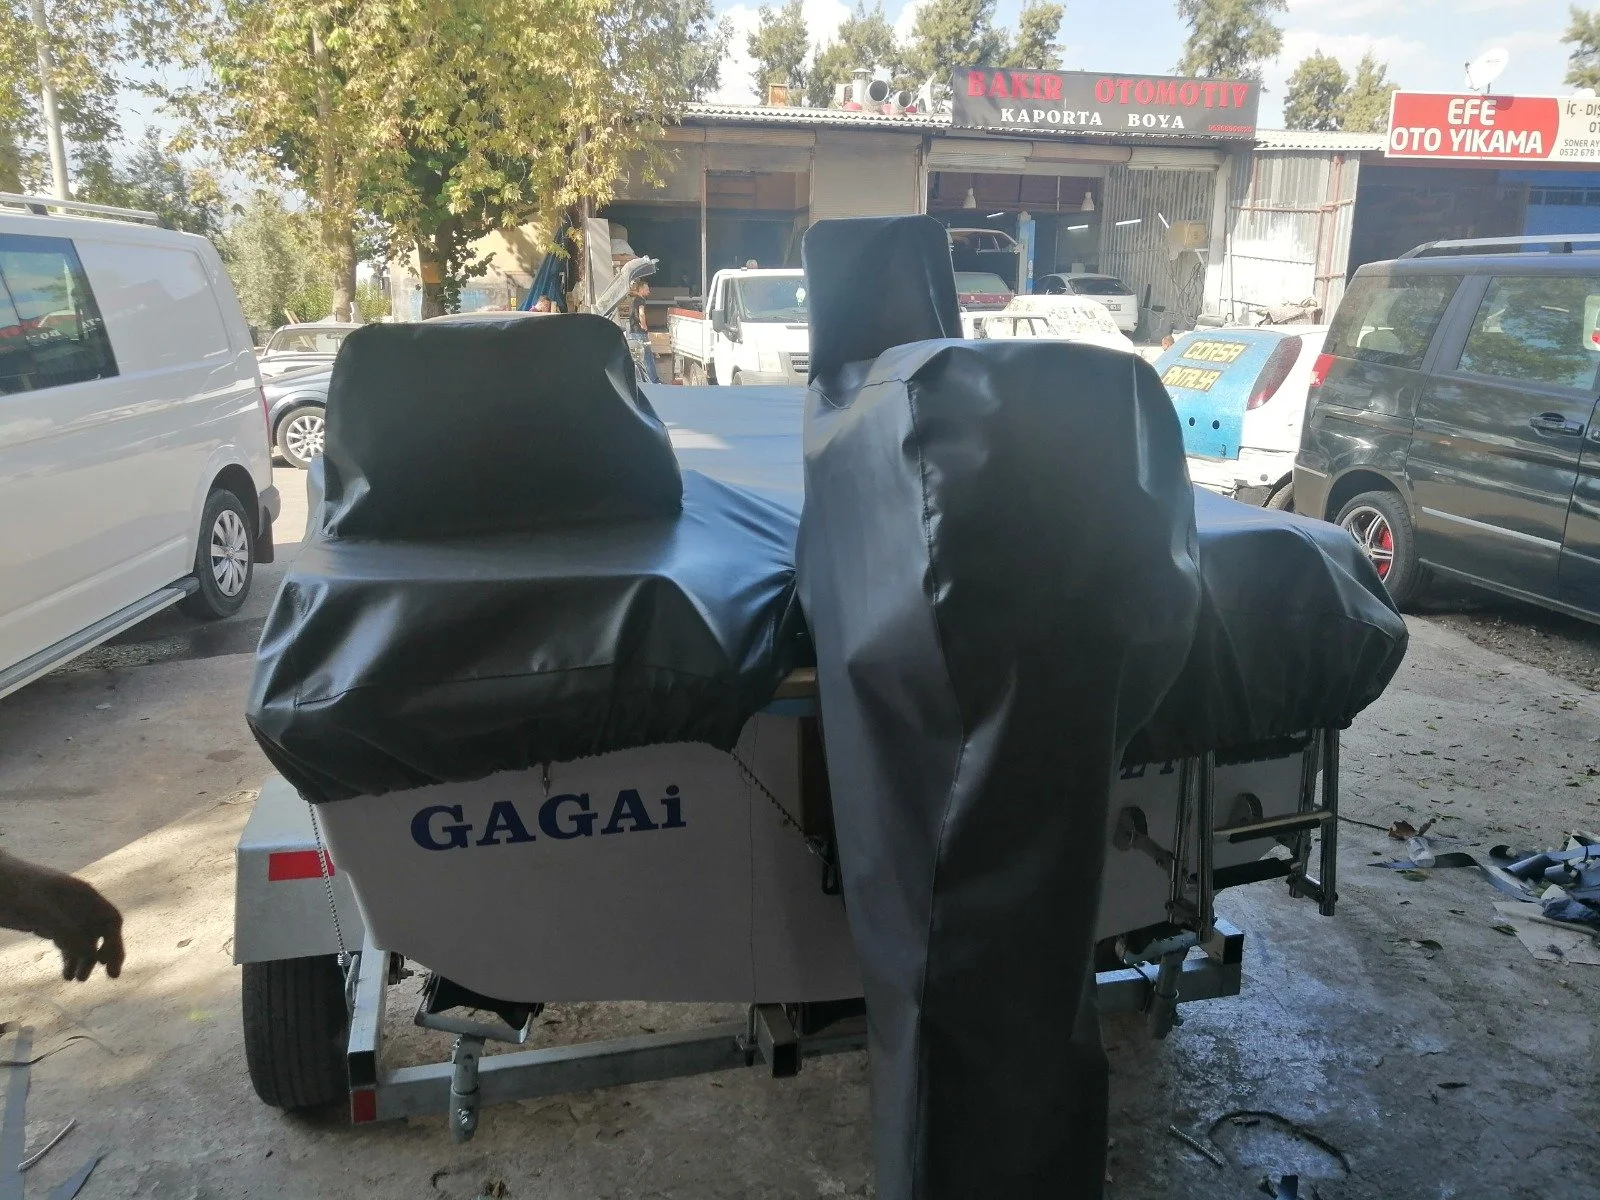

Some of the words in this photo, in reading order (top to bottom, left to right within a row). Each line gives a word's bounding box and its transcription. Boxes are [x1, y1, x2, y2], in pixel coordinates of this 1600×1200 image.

[967, 71, 1064, 100] BAKIR
[1000, 108, 1103, 126] KAPORTA
[1127, 112, 1185, 129] BOYA
[1447, 98, 1497, 126] EFE
[1566, 100, 1577, 118] İÇ
[1390, 126, 1442, 152] OTO
[1449, 128, 1543, 154] YIKAMA
[1564, 139, 1588, 148] SONER
[1559, 148, 1579, 157] 0532
[1580, 148, 1595, 157] 678
[1182, 340, 1247, 363] CORSA
